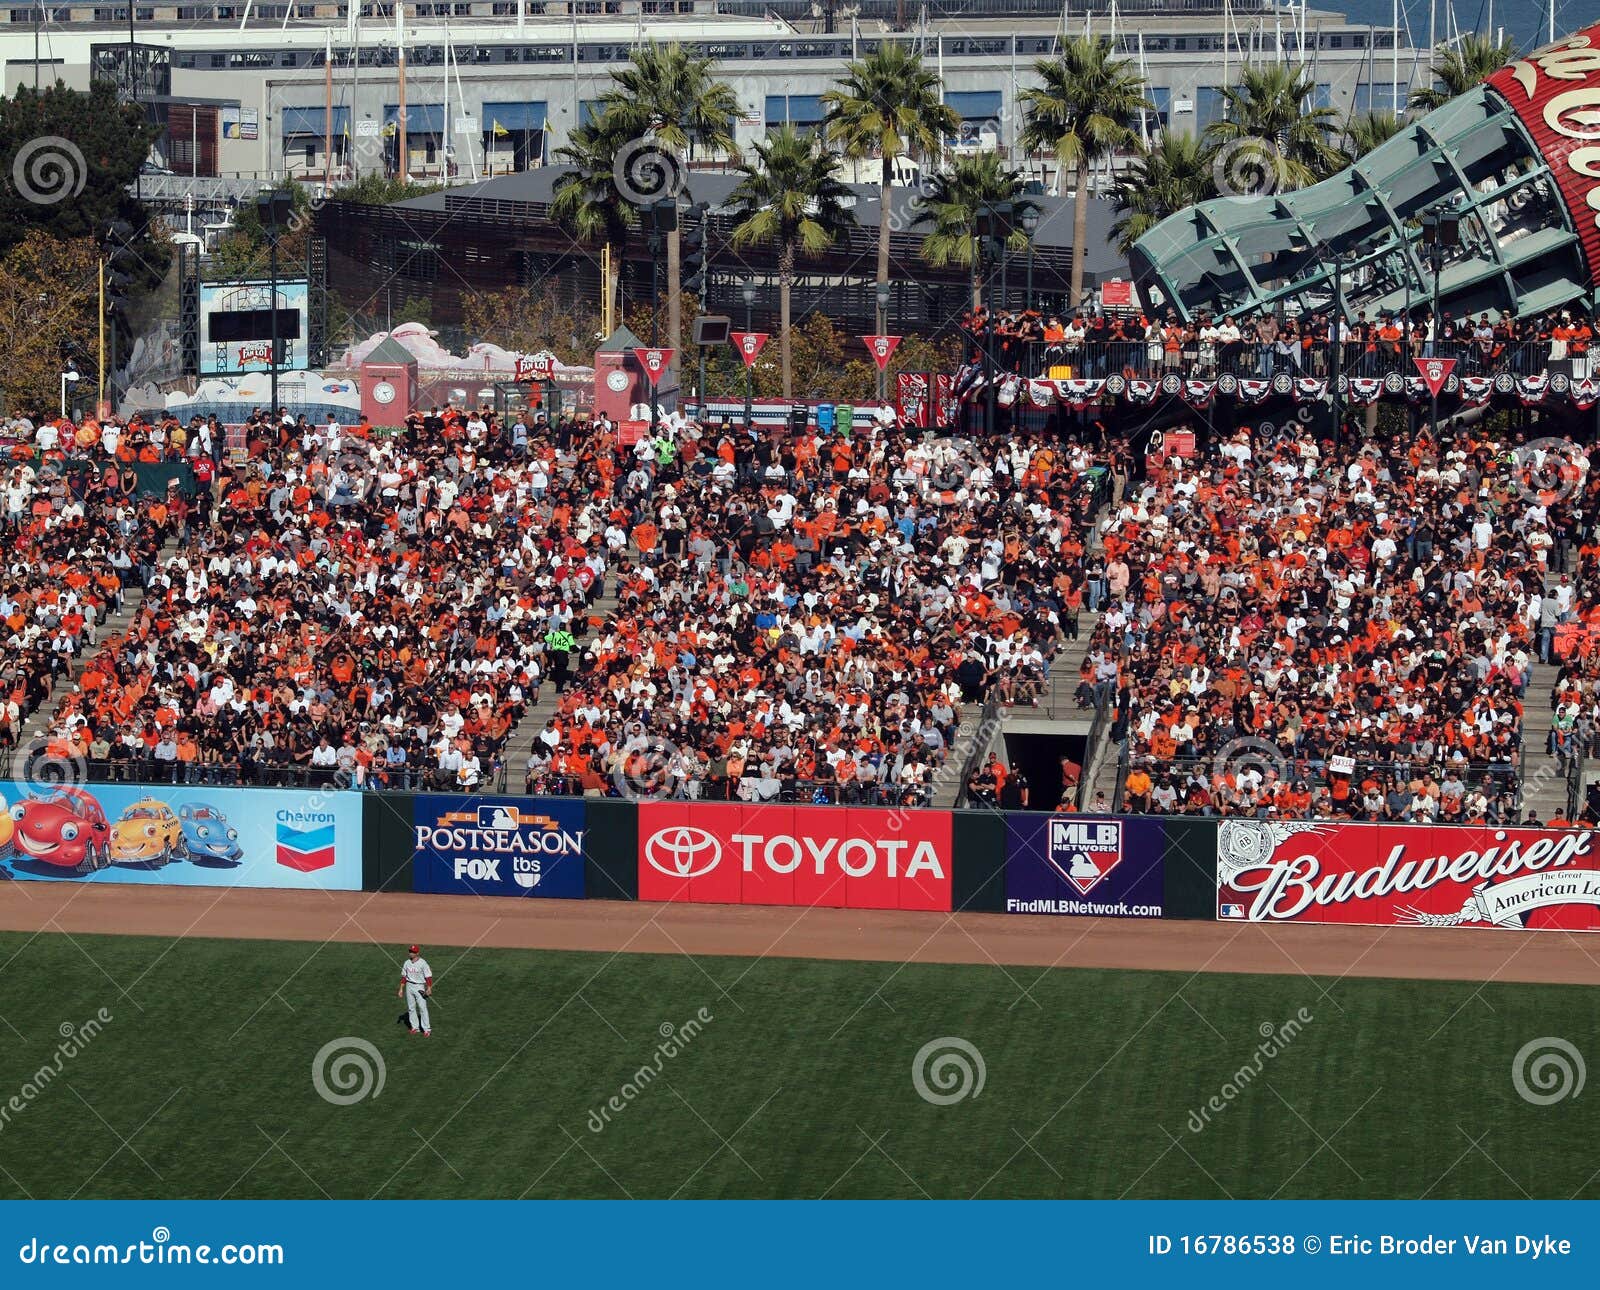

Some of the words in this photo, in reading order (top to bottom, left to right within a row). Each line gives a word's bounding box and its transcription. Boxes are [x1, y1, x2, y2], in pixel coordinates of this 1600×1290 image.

[554, 637, 567, 646] 142
[276, 809, 336, 823] Chevron
[415, 825, 584, 855] POSTSEASON
[1053, 823, 1118, 845] MLB
[731, 833, 945, 879] TOYOTA
[1053, 844, 1118, 852] NETWORK
[454, 858, 502, 881] FOX
[513, 856, 541, 872] tbs
[1228, 831, 1592, 921] Budweiser
[1540, 873, 1555, 881] The
[1557, 871, 1582, 879] Great
[1494, 880, 1577, 913] American
[1007, 898, 1162, 917] FindMLBNetwork.com
